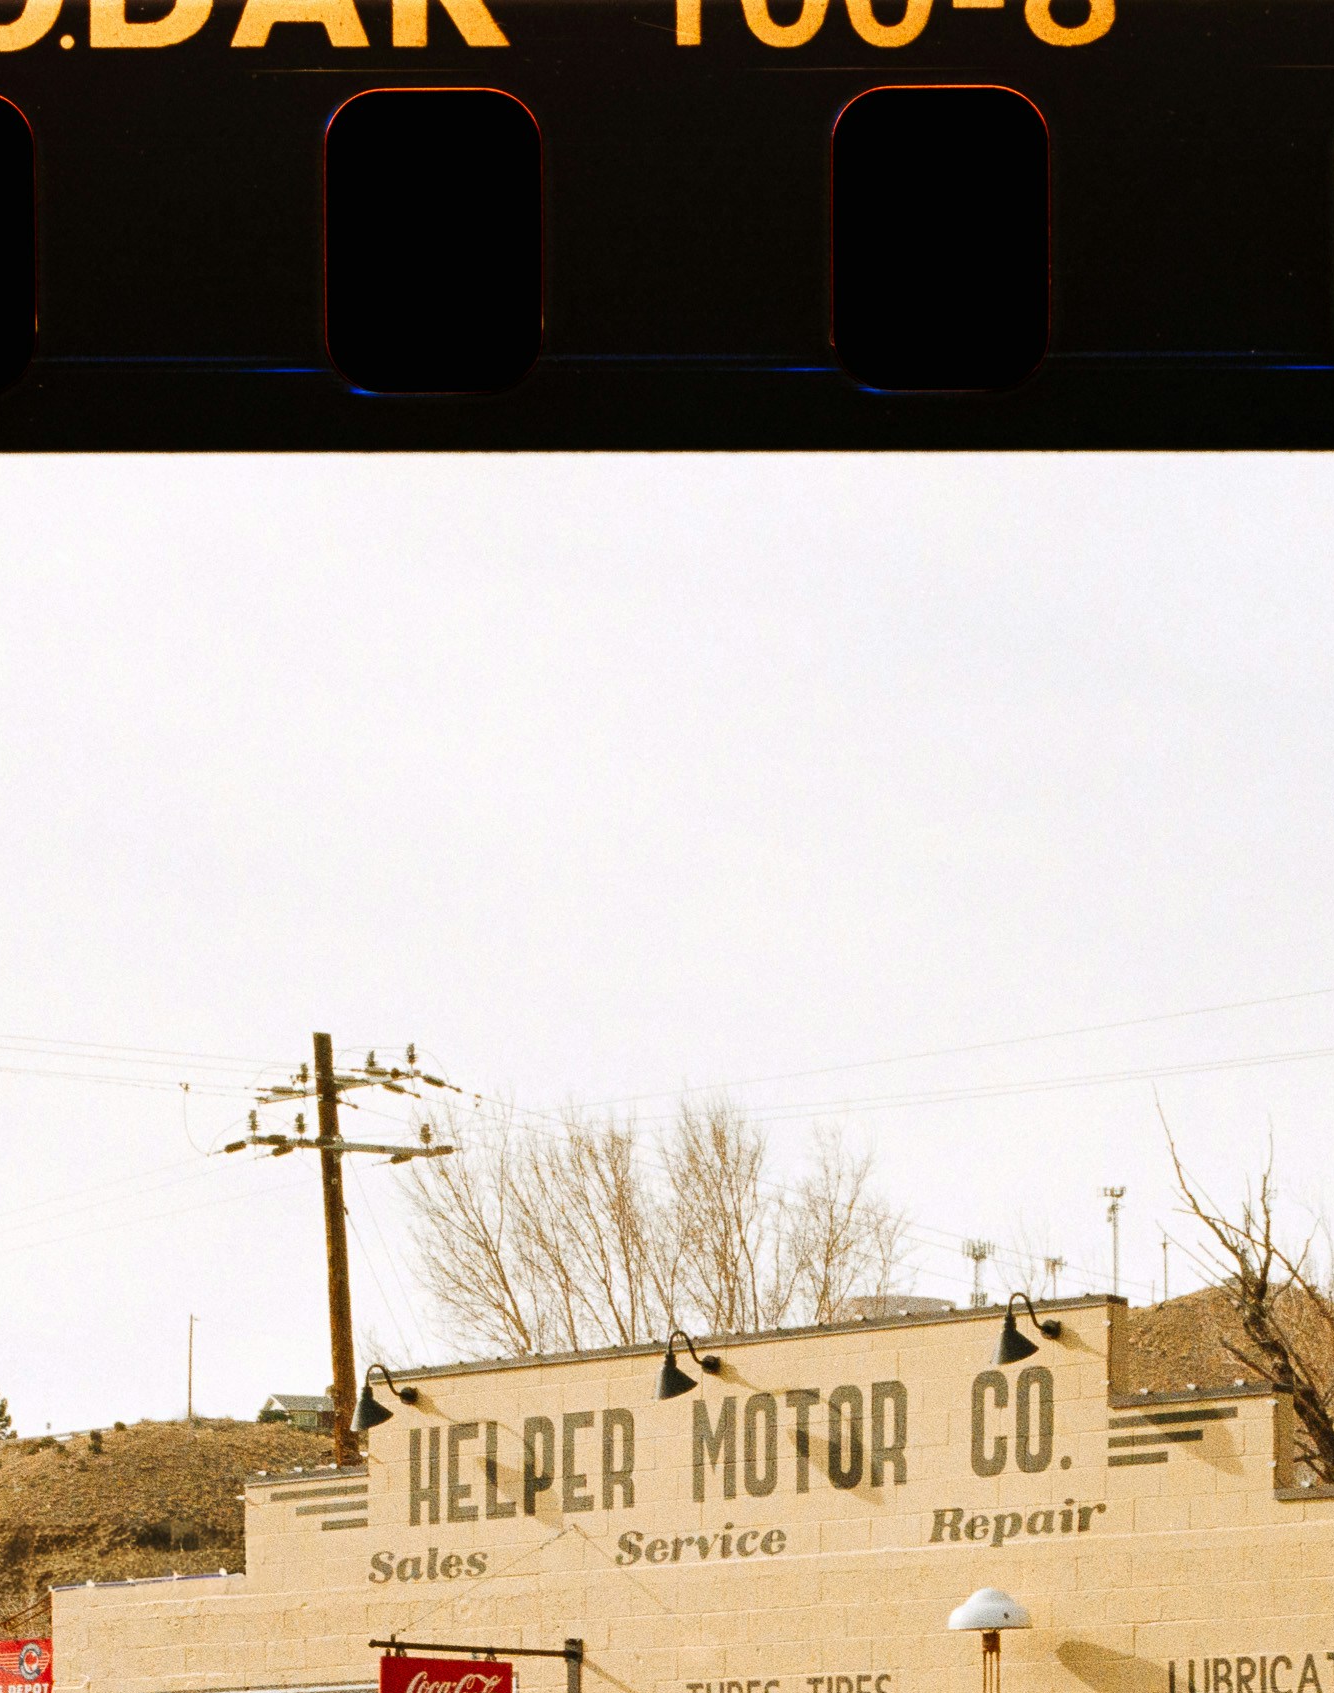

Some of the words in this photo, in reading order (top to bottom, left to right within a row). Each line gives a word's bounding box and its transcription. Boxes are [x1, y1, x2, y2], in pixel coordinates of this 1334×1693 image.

[409, 1408, 635, 1526] HELPER
[692, 1380, 907, 1504] MOTOR
[971, 1366, 1071, 1478] CO.
[368, 1546, 488, 1585] Sales
[616, 1521, 787, 1566] Service
[929, 1499, 1106, 1548] Repair
